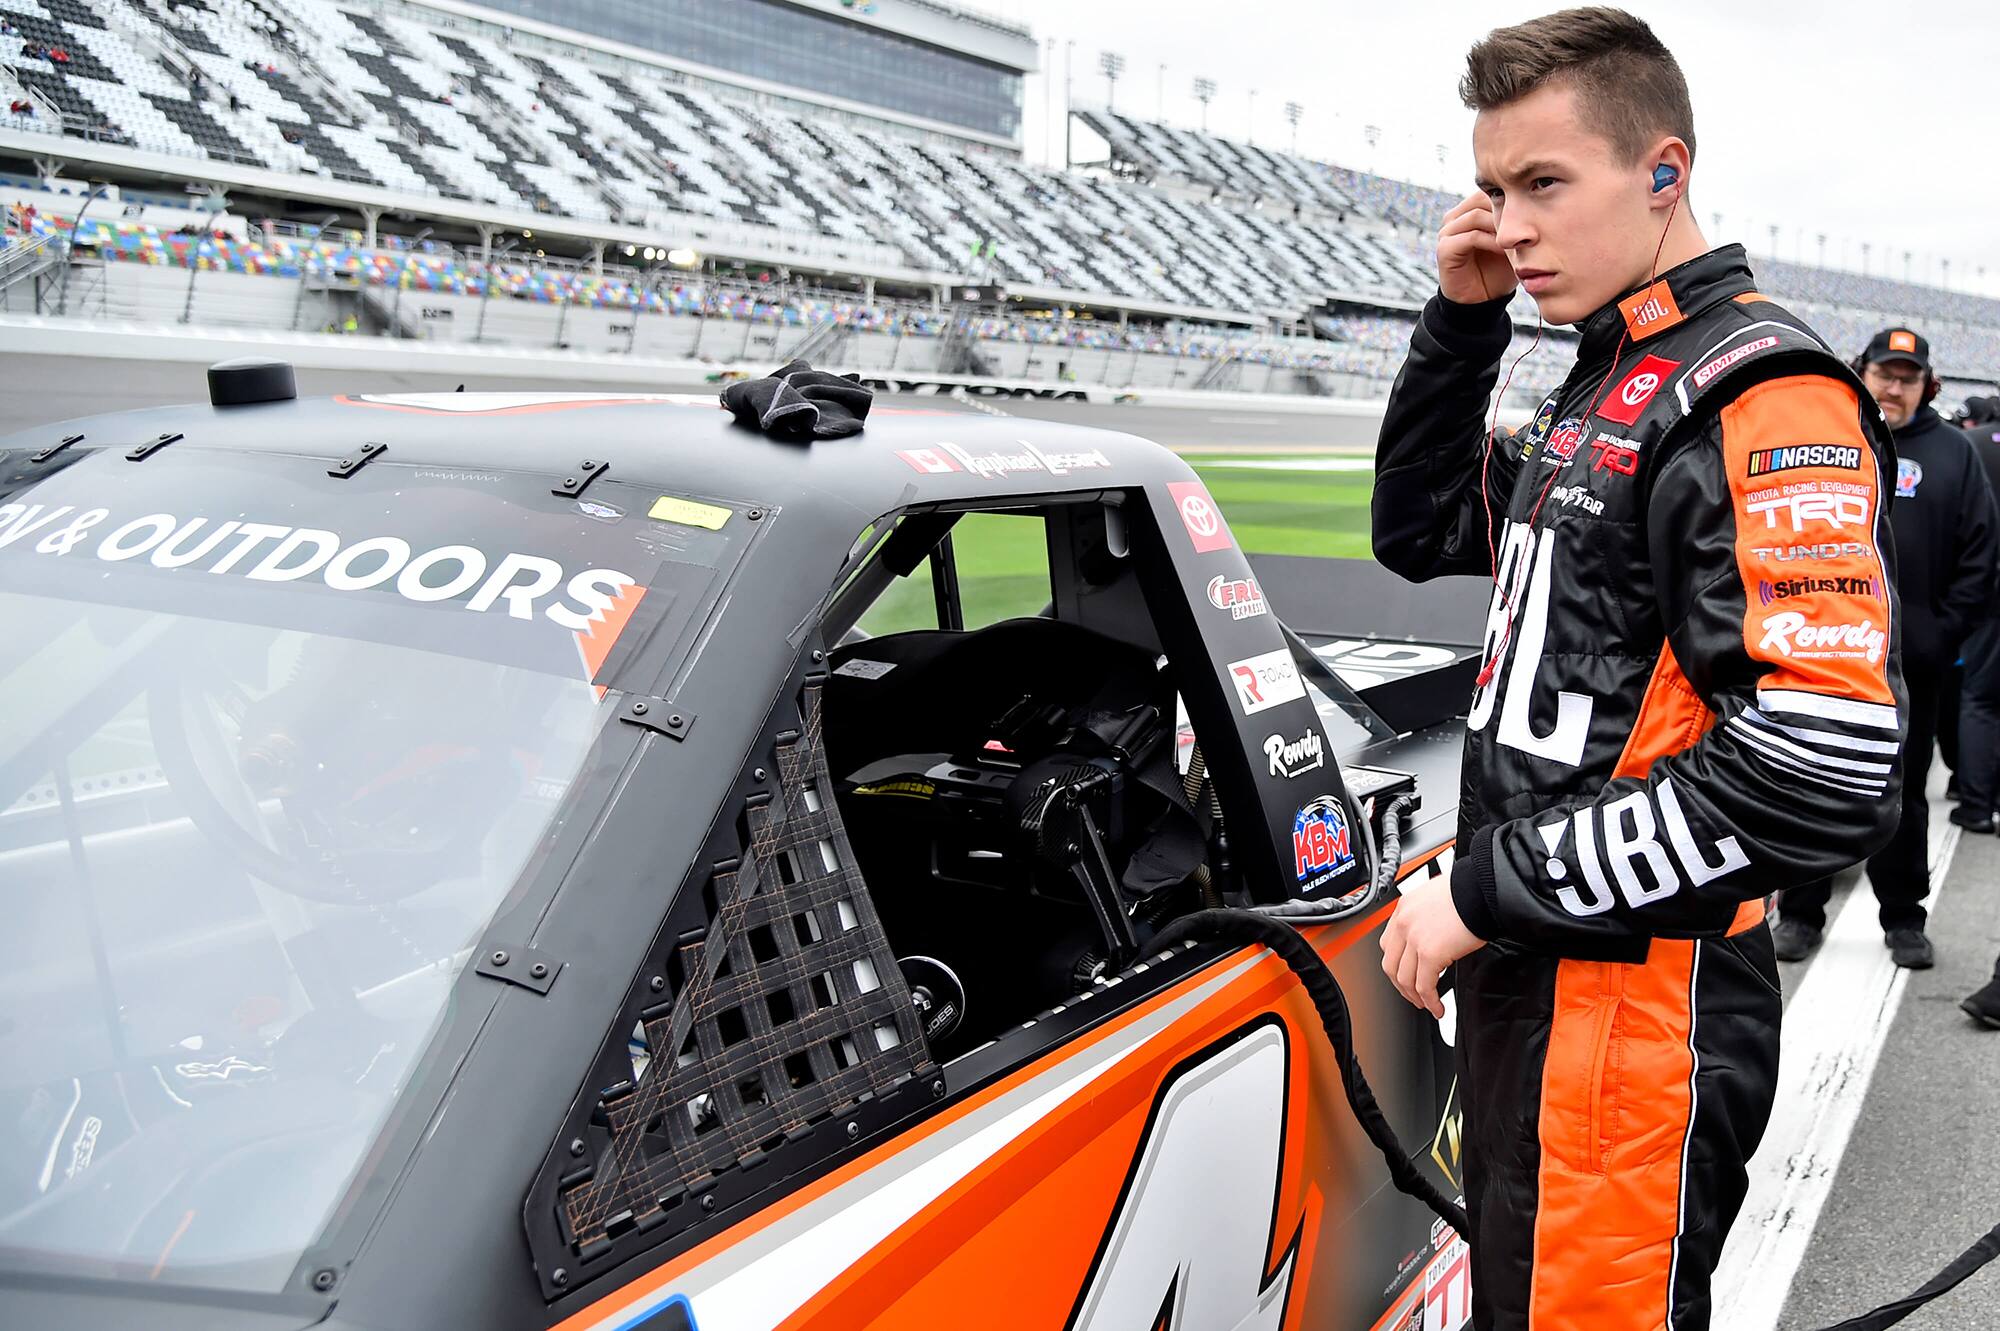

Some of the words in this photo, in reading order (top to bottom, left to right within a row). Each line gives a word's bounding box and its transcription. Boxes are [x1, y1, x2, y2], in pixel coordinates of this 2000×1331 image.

[1632, 298, 1670, 326] JBL
[1699, 339, 1770, 384] SIMPSON
[1781, 445, 1859, 468] NASCAR
[1745, 488, 1779, 503] TOYOTA
[1783, 482, 1817, 495] RACING
[1821, 481, 1871, 498] DEVELOPMENT
[1746, 492, 1869, 533] TRD
[36, 508, 110, 556] &
[97, 513, 637, 631] OUTDOORS
[1219, 580, 1261, 607] FRL
[1233, 603, 1266, 619] EXPRESS
[1758, 611, 1885, 664] Rowdy
[1263, 728, 1324, 777] Rowdy
[1292, 819, 1352, 880] KBM
[1537, 777, 1752, 917] JBL
[926, 1004, 954, 1036] JOES
[1064, 1018, 1298, 1331] 4
